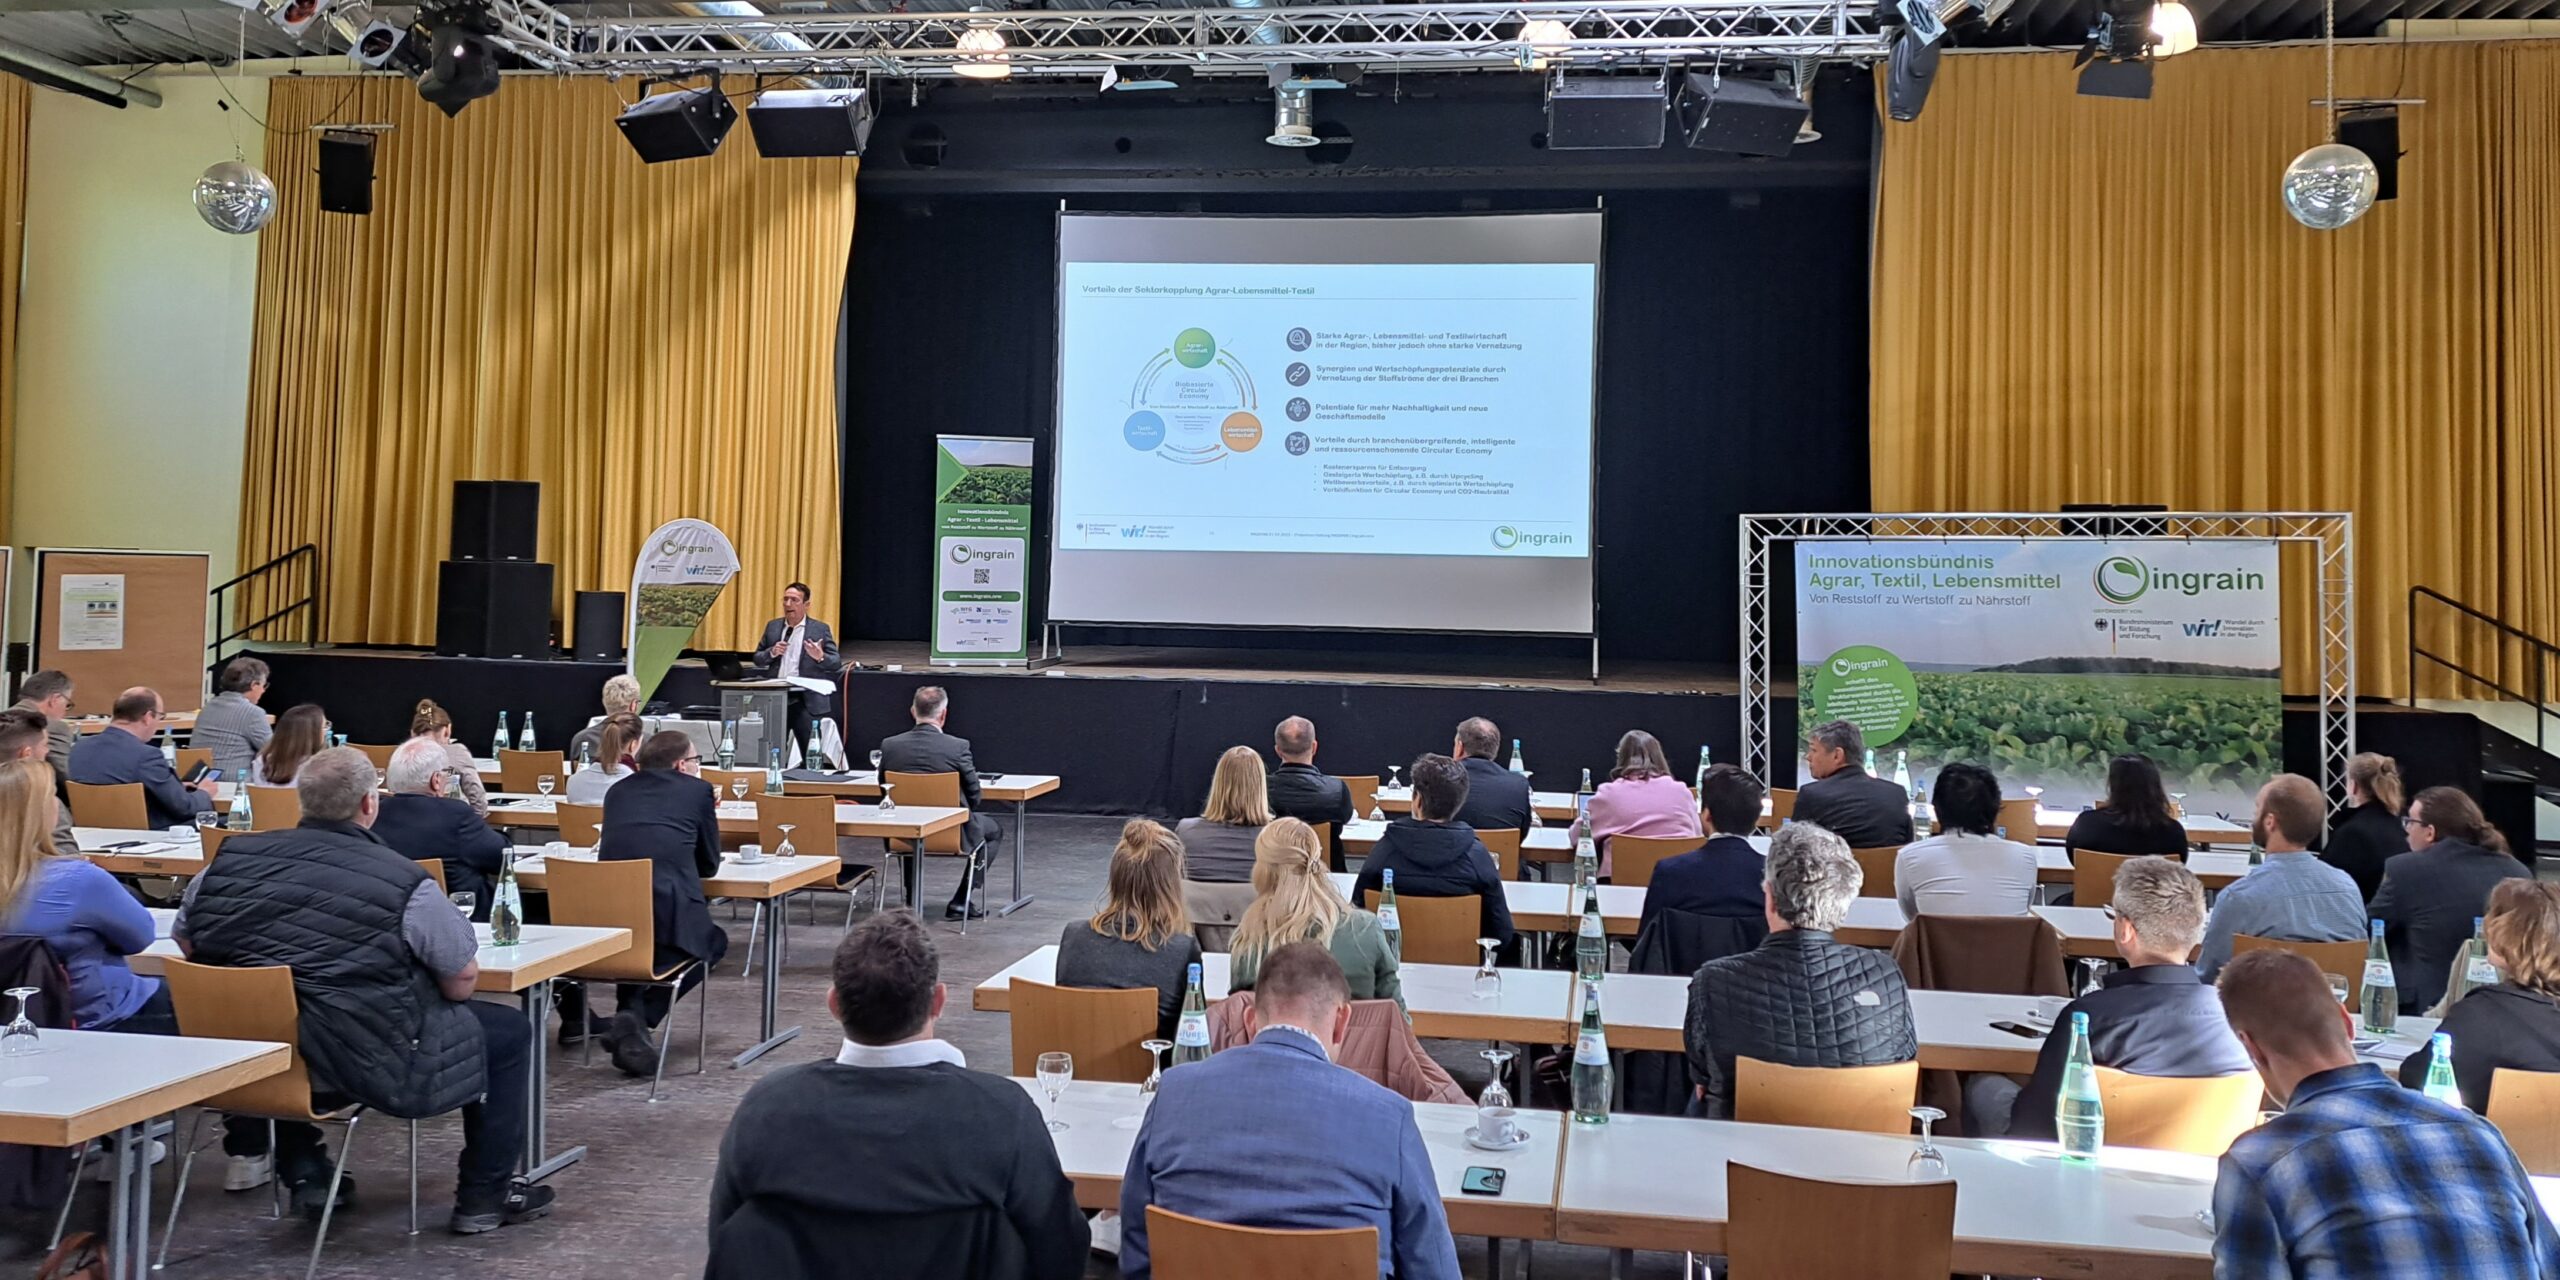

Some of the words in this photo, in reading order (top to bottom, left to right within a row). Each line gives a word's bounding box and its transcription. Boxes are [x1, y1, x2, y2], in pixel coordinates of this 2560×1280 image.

[1082, 285, 1117, 294] Vorteile
[1117, 285, 1132, 294] der
[1134, 285, 1203, 296] Sektorkopplung
[1205, 286, 1315, 296] Agrar-Lebensmittel-Textil
[1316, 332, 1342, 340] Starke
[1343, 332, 1371, 341] Agrar-,
[1373, 332, 1427, 340] Lebensmittel-
[1428, 332, 1444, 340] und
[1446, 332, 1507, 340] Textilwirtschaft
[1340, 342, 1370, 350] Region,
[1398, 342, 1425, 350] jedoch
[1476, 342, 1522, 351] Vernetzung
[1316, 365, 1356, 374] Synergien
[1358, 365, 1373, 373] und
[1374, 365, 1481, 374] Wertschöpfungspotenziale
[1482, 365, 1506, 373] durch
[1316, 374, 1362, 383] Vernetzung
[1363, 374, 1377, 382] der
[1378, 374, 1425, 382] Stoffströme
[1426, 374, 1440, 382] der
[1442, 374, 1458, 382] drei
[1459, 374, 1499, 382] Branchen
[1316, 404, 1355, 412] Potentiale
[1356, 404, 1368, 412] für
[1369, 404, 1390, 412] mehr
[1392, 404, 1450, 413] Nachhaltigkeit
[1451, 404, 1466, 412] und
[1315, 413, 1386, 421] Geschäftsmodelle
[1314, 436, 1345, 444] Vorteile
[1347, 436, 1370, 444] durch
[1372, 437, 1469, 446] branchenübergreifende,
[1470, 437, 1516, 446] intelligente
[1314, 445, 1329, 453] und
[1331, 446, 1419, 454] ressourcenschonende
[1455, 447, 1493, 455] Economy
[1519, 531, 1572, 546] ingrain
[679, 544, 714, 554] ingrain
[972, 548, 1015, 561] ingrain
[1809, 554, 1994, 569] Innovationsbündnis
[685, 565, 706, 575] wir!
[1809, 572, 1865, 590] Agrar,
[1871, 572, 1927, 590] Textil,
[1933, 573, 2061, 589] Lebensmittel
[2153, 567, 2264, 596] ingrain
[1809, 593, 1828, 605] Von
[1832, 593, 1881, 605] Reststoff
[1885, 596, 1899, 605] zu
[1902, 594, 1954, 605] Wertstoff
[1958, 597, 1972, 606] zu
[1976, 594, 2031, 606] Nährstoff
[2128, 625, 2150, 634] Bildung
[2182, 619, 2221, 637] wir!
[2132, 633, 2161, 641] Forschung
[1850, 658, 1889, 671] ingrain
